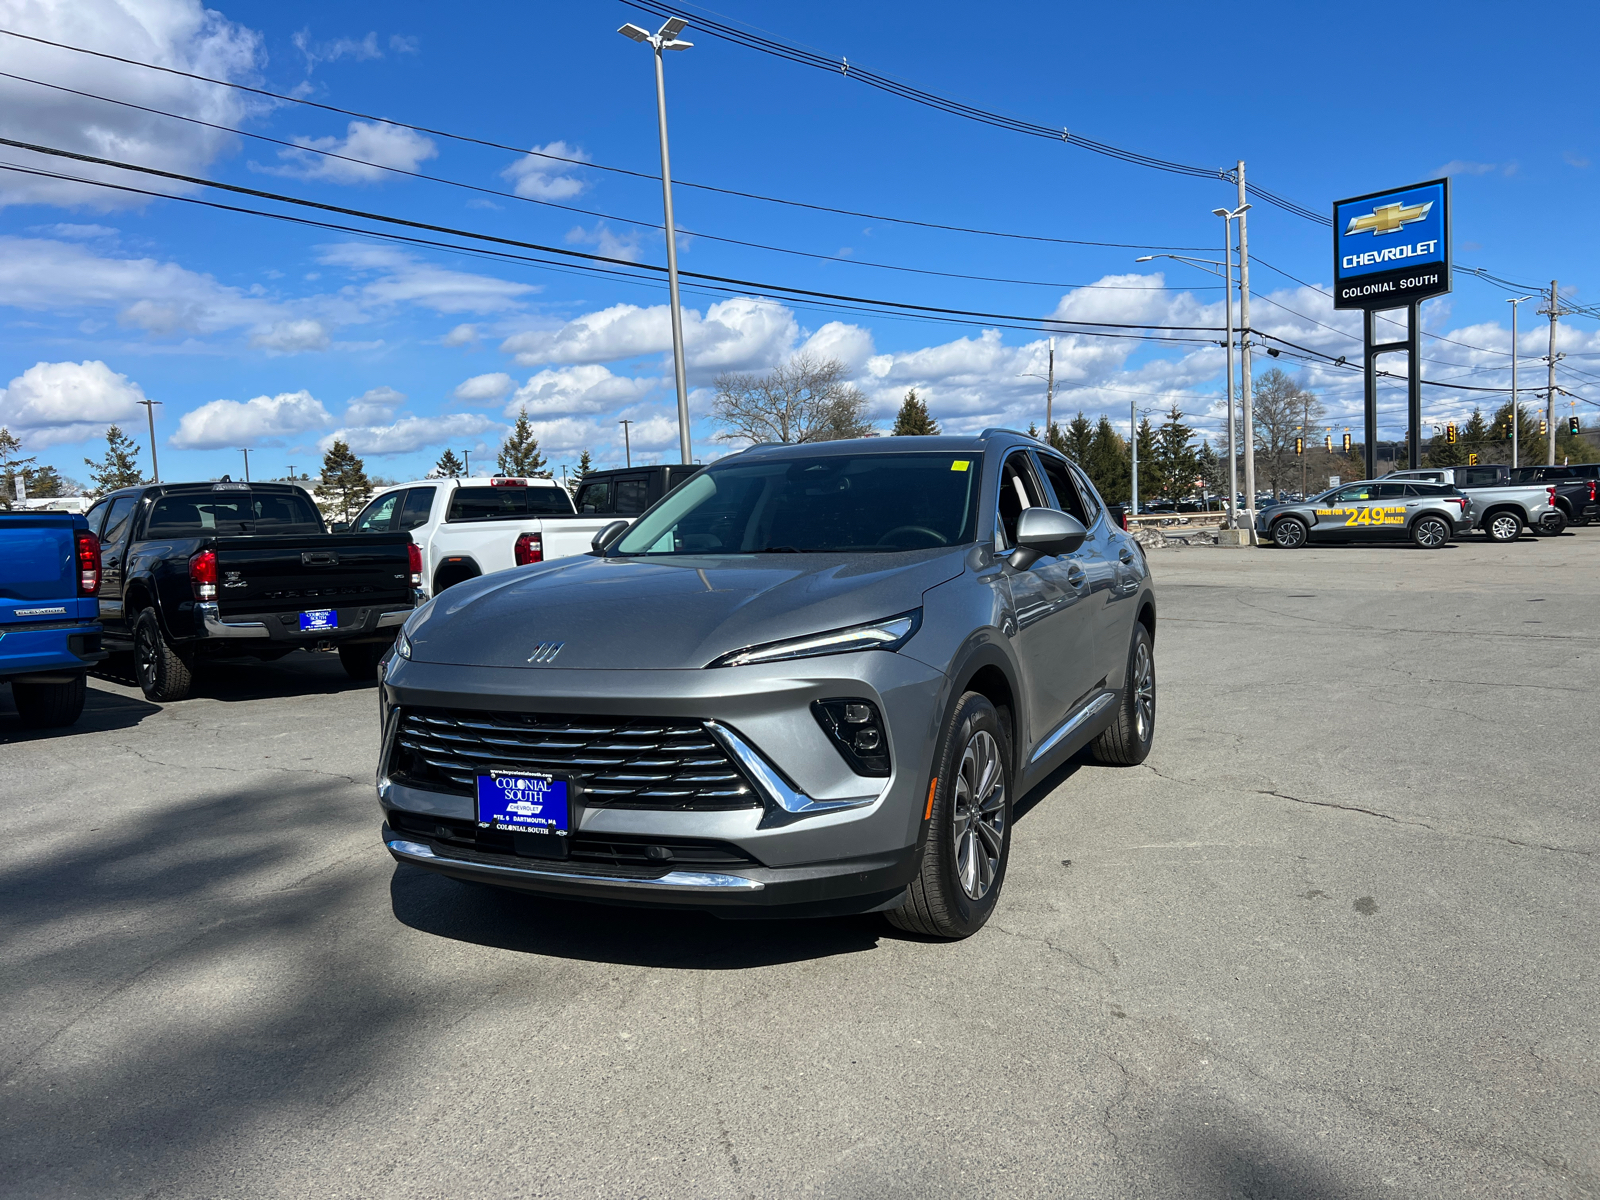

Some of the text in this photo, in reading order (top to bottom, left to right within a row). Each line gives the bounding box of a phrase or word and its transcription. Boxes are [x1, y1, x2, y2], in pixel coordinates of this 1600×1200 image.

[1343, 240, 1438, 269] CHEVROLET
[1342, 274, 1438, 299] COLONIAL SOUTH
[264, 585, 374, 599] TACOMA
[496, 778, 552, 792] COLONIAL
[504, 789, 544, 803] SOUTH
[509, 804, 540, 812] CHEVROLET
[513, 816, 547, 825] DARTMOUTH,
[496, 824, 527, 832] COLONIAL
